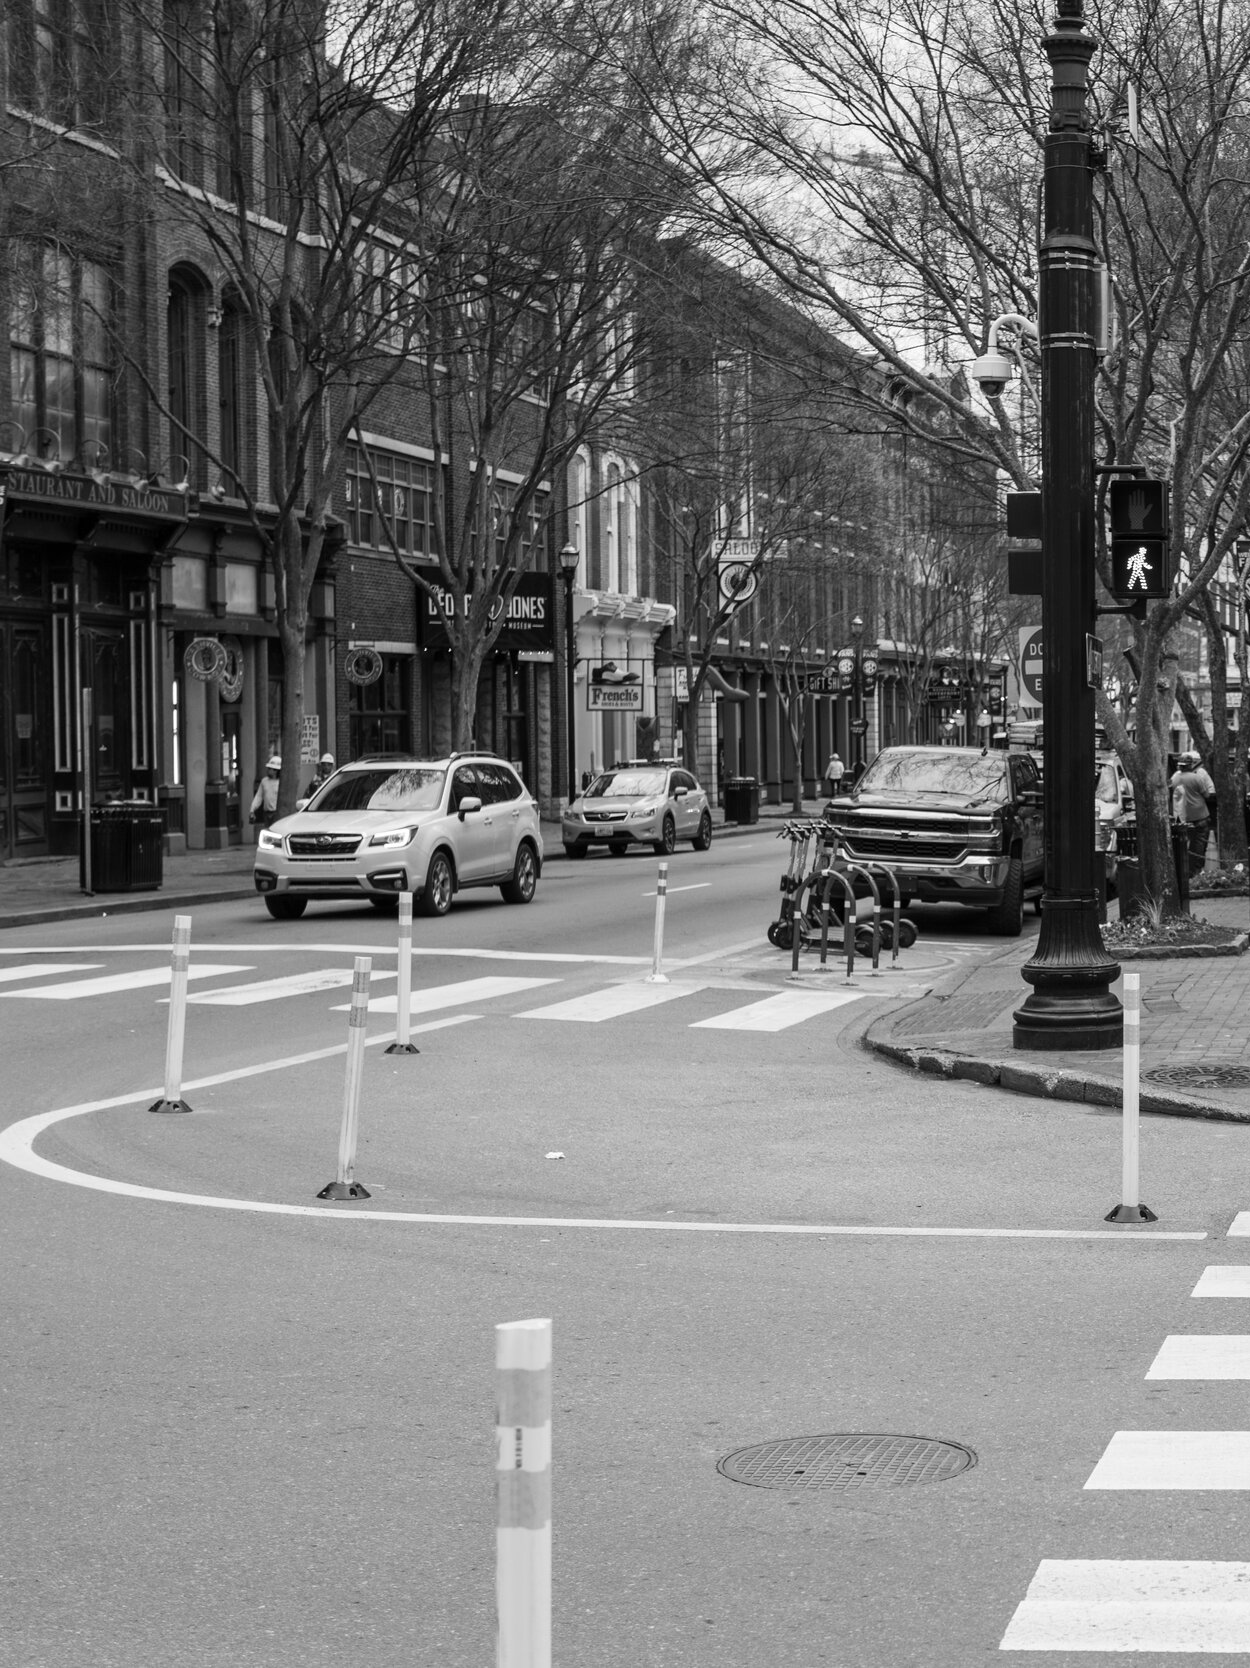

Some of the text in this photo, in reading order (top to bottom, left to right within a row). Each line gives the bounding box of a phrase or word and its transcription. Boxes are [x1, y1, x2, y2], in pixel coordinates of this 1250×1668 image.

[7, 471, 83, 499] STAURANT
[88, 483, 116, 504] AND
[121, 488, 169, 512] SALOON
[714, 541, 758, 555] SALOO
[506, 596, 546, 619] JONES
[809, 677, 840, 691] GIFT SH
[591, 687, 639, 705] French's
